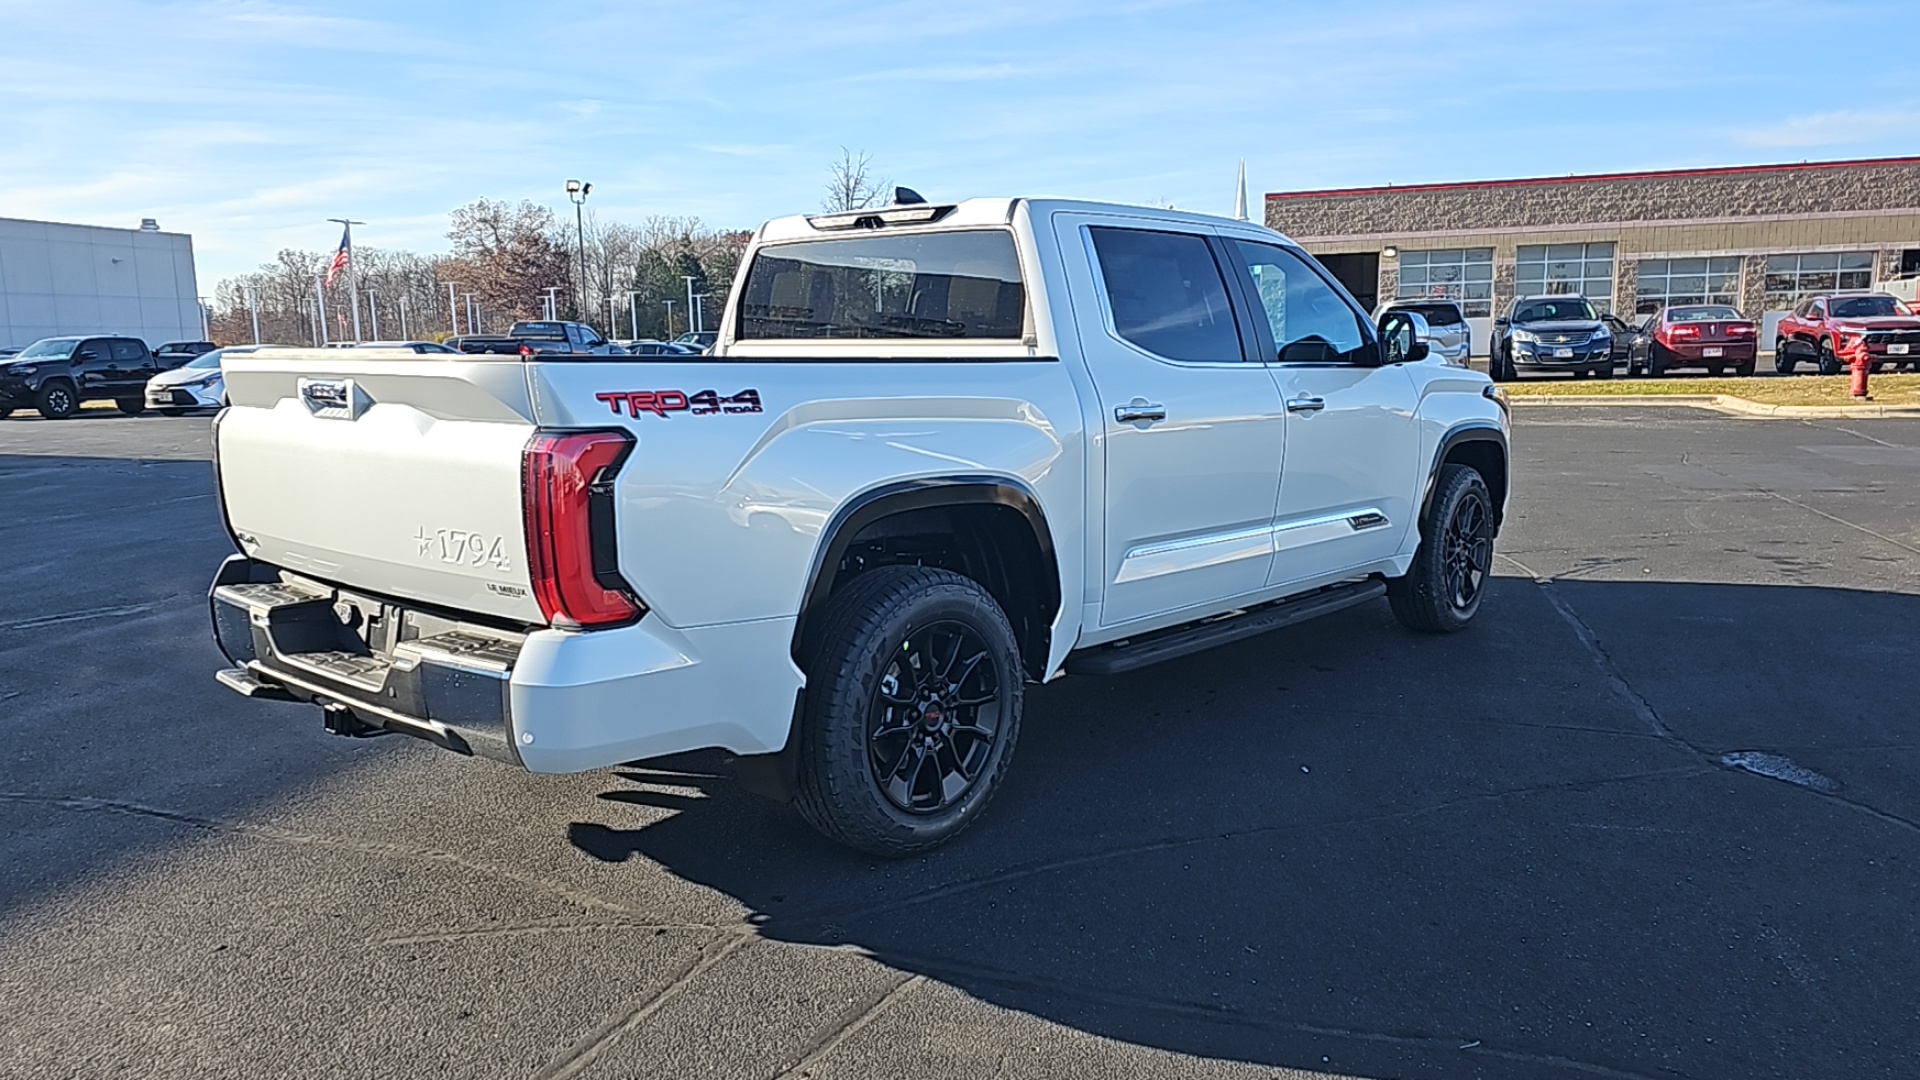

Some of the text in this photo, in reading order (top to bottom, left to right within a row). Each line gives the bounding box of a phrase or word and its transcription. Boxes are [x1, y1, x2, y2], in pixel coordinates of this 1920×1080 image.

[596, 390, 691, 420] TRD
[723, 406, 763, 414] ROAD
[437, 529, 511, 571] 1794
[486, 583, 497, 591] LE
[498, 585, 529, 597] MIEUX
